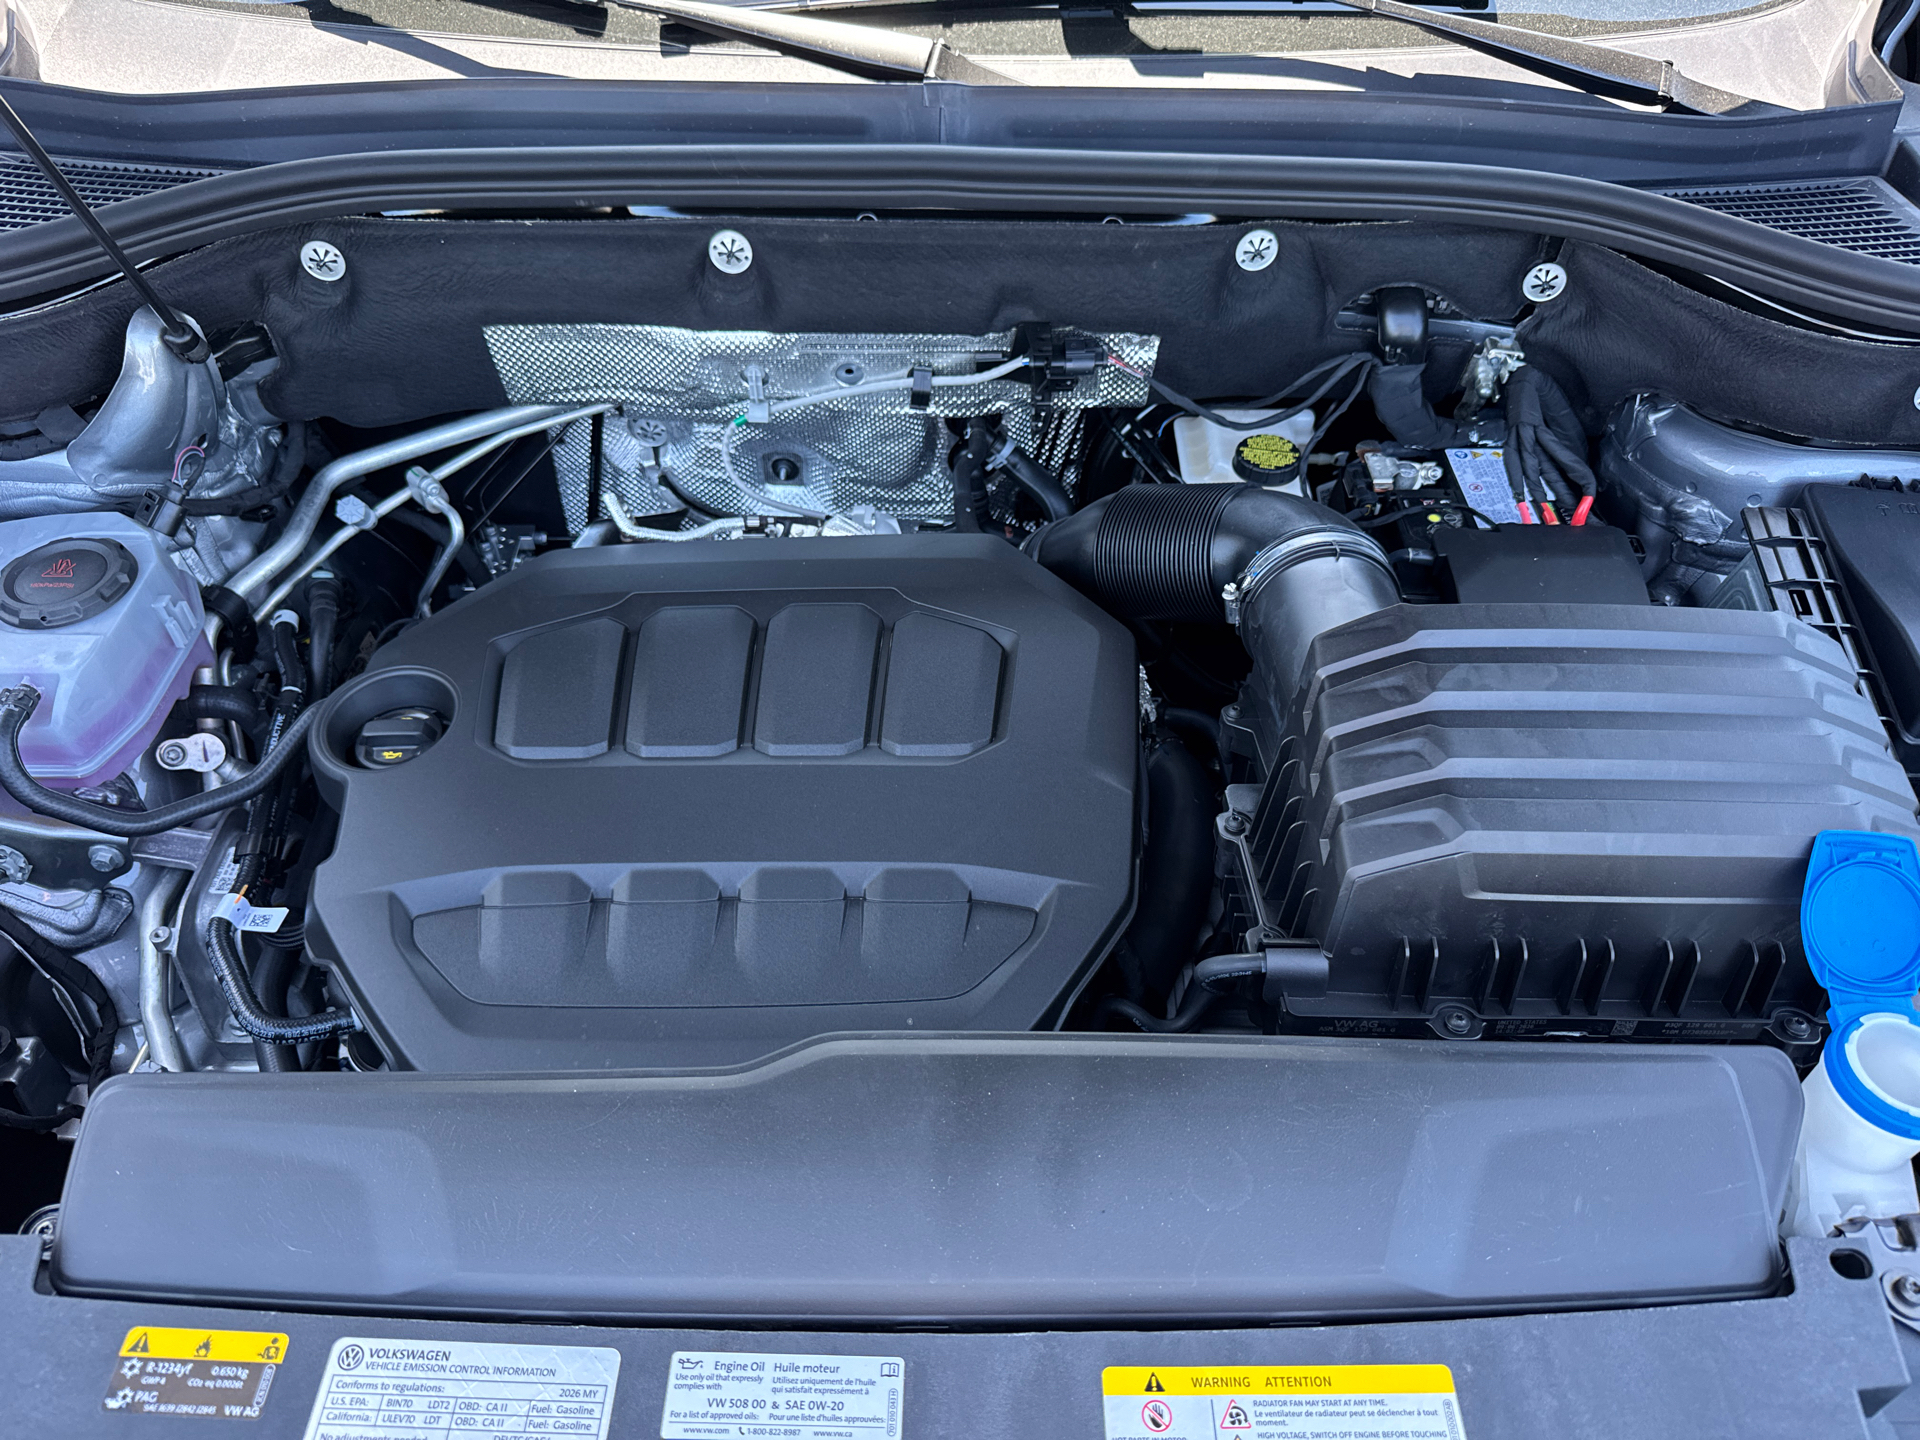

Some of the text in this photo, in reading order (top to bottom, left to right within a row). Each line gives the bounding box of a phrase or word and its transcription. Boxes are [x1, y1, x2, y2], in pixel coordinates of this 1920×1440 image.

[1335, 1020, 1379, 1028] VW AG
[369, 1348, 451, 1362] VOLKSWAGEN
[146, 1362, 249, 1380] R-1234yf 0.650 kg
[365, 1361, 557, 1377] VEHICLE EMISSION CONTROL INFORMATION
[714, 1362, 765, 1374] Engine Oil
[774, 1363, 840, 1374] Huile moteur
[675, 1373, 764, 1385] Use only oil that expressly
[772, 1376, 876, 1387] Utilisez uniquement de l'huile
[1191, 1376, 1332, 1389] WARNING ATTENTION
[336, 1379, 445, 1395] Conforms to regulations:
[674, 1383, 722, 1392] complies with
[772, 1386, 869, 1396] qui satisfait expressément à
[134, 1391, 159, 1402] PAG
[559, 1388, 599, 1399] 2026 MY
[330, 1397, 369, 1407] U.S. EPA:
[386, 1399, 451, 1410] BIN70 LDT2
[458, 1402, 482, 1411] OBD:
[486, 1403, 500, 1412] CA
[707, 1398, 844, 1411] VW 508 00 & SAE 0W-20
[1253, 1399, 1288, 1407] RADIATOR
[1289, 1399, 1304, 1407] FAN
[1305, 1399, 1319, 1407] MAY
[1321, 1399, 1343, 1407] START
[143, 1404, 159, 1413] SAE
[224, 1405, 260, 1417] VW AG
[531, 1404, 595, 1416] Fuel: Gasoline
[1255, 1409, 1262, 1418] Le
[1264, 1409, 1304, 1418] ventilateur
[1305, 1409, 1314, 1418] de
[1315, 1409, 1347, 1418] radiateur
[1348, 1409, 1364, 1419] peut
[1376, 1408, 1415, 1417] déclencher
[1423, 1409, 1438, 1417] tout
[326, 1411, 372, 1423] California:
[382, 1414, 442, 1425] ULEV70 LDT
[670, 1411, 681, 1419] For
[688, 1411, 698, 1419] list
[700, 1411, 709, 1419] of
[710, 1412, 741, 1421] approved
[743, 1412, 760, 1420] oils:
[769, 1413, 783, 1421] Pour
[799, 1413, 814, 1422] liste
[816, 1414, 843, 1422] d'huiles
[844, 1415, 886, 1424] approuvées:
[454, 1417, 478, 1426] OBD:
[482, 1418, 497, 1427] CA
[528, 1419, 592, 1431] Fuel: Gasoline
[1255, 1419, 1289, 1427] moment.
[683, 1427, 801, 1436] www.vw.com 1-800-822-8987
[1276, 1431, 1309, 1440] VOLTAGE,
[1310, 1431, 1335, 1439] SWITCH
[1336, 1431, 1351, 1439] OFF
[1353, 1431, 1379, 1439] ENGINE
[1381, 1431, 1408, 1439] BEFORE
[1410, 1430, 1447, 1439] TOUCHING
